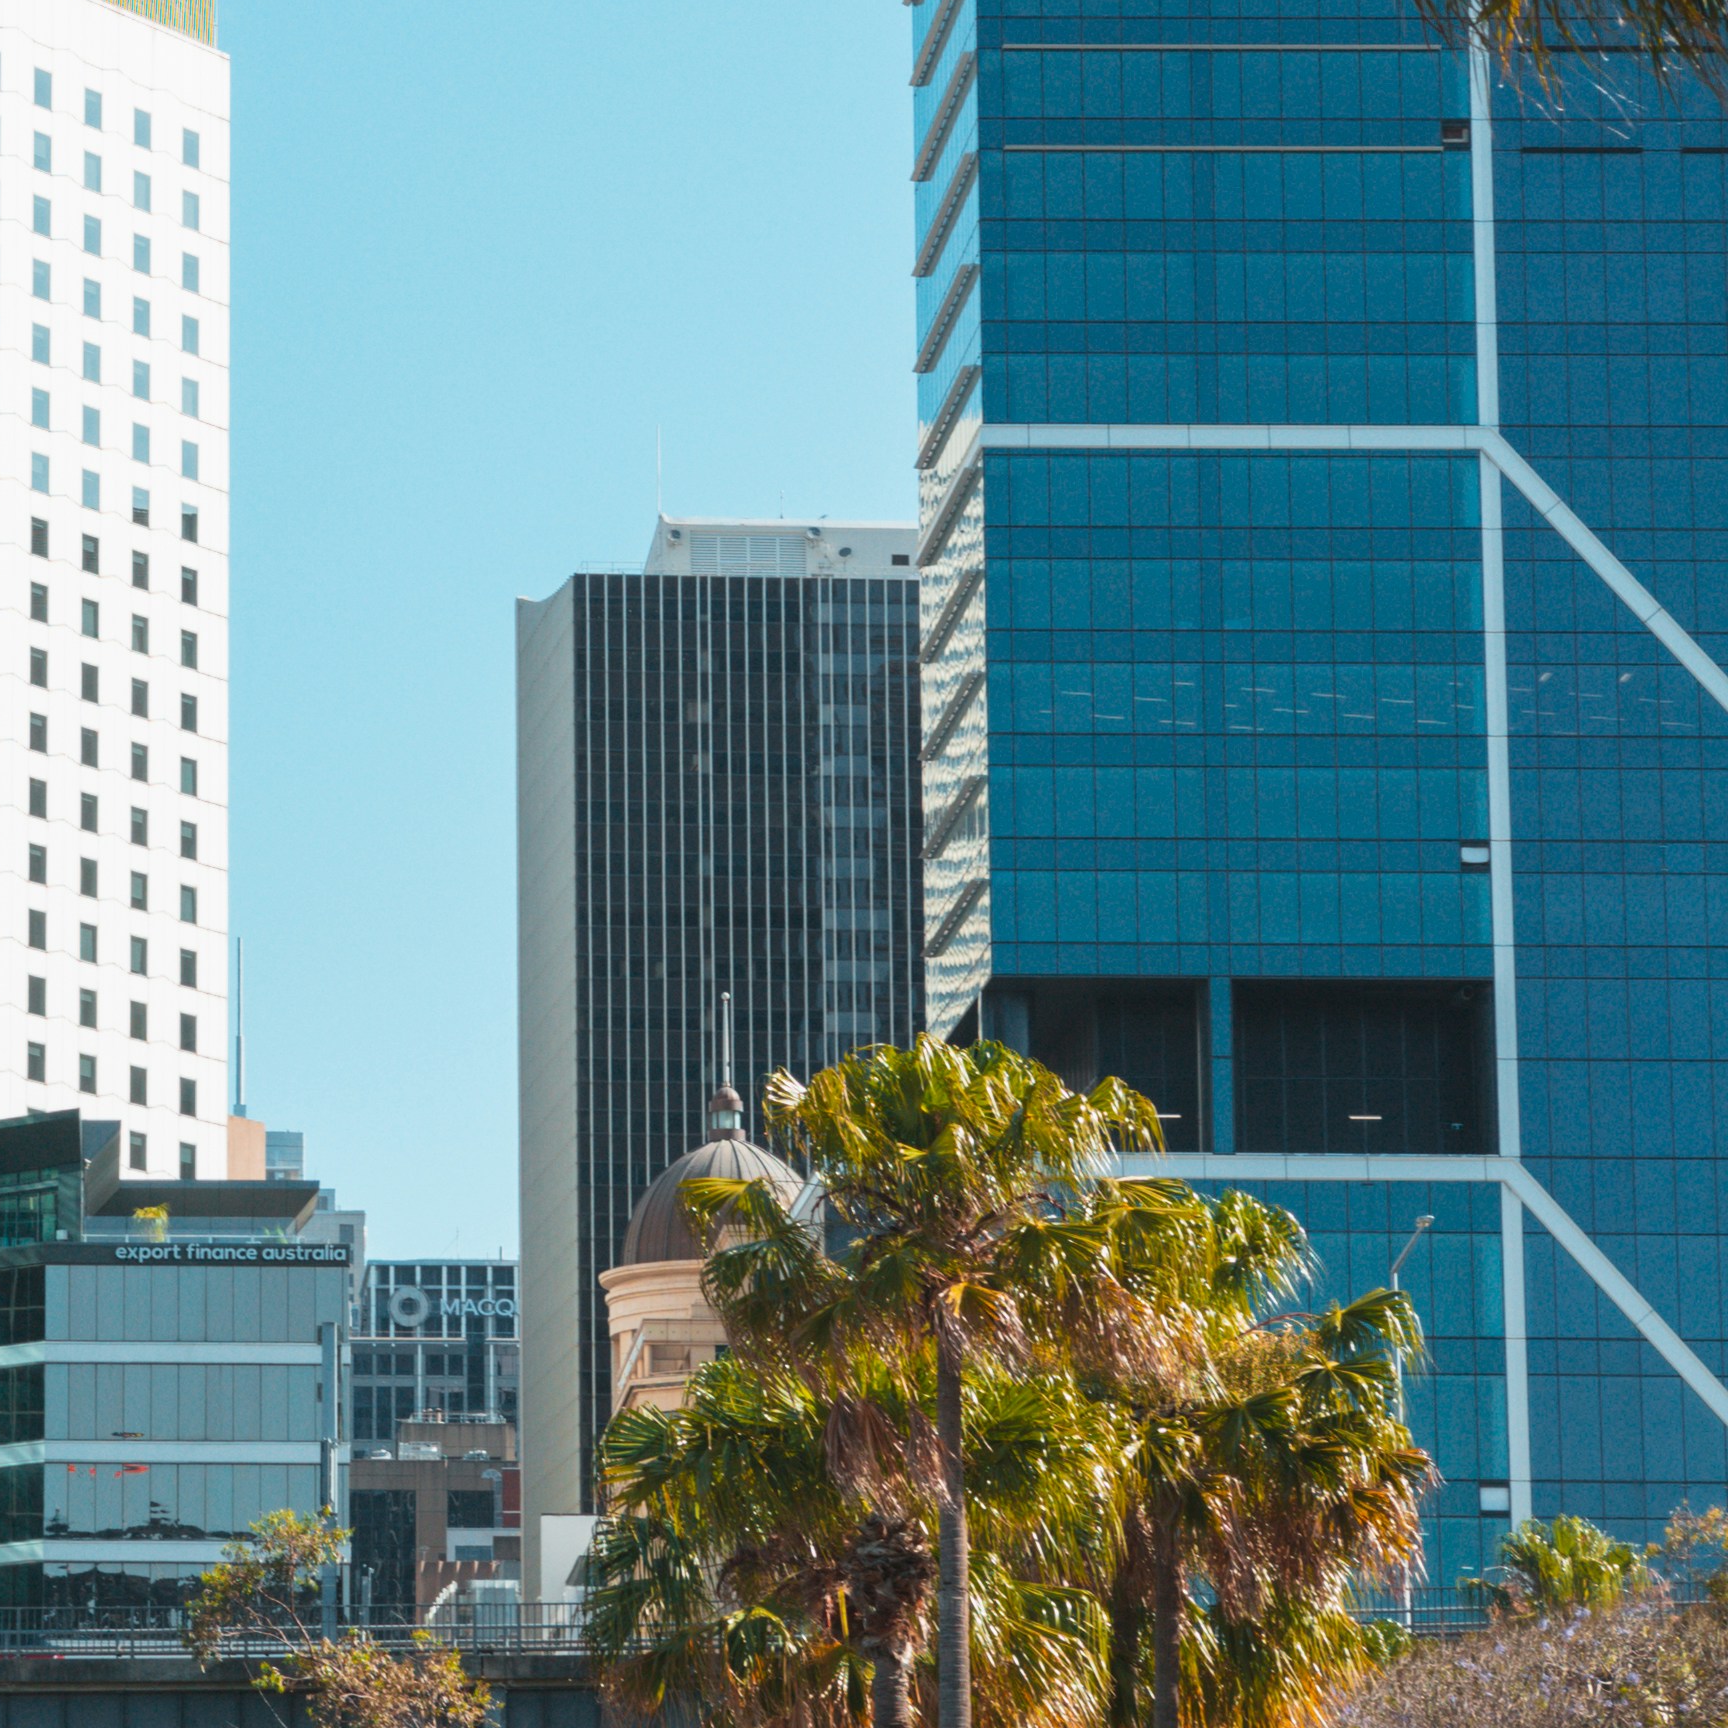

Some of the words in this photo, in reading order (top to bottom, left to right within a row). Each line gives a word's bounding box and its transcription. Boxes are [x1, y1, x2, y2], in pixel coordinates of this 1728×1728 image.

[115, 1244, 181, 1263] export
[186, 1243, 258, 1261] finance
[262, 1243, 347, 1261] australia
[440, 1298, 519, 1318] MACQ
